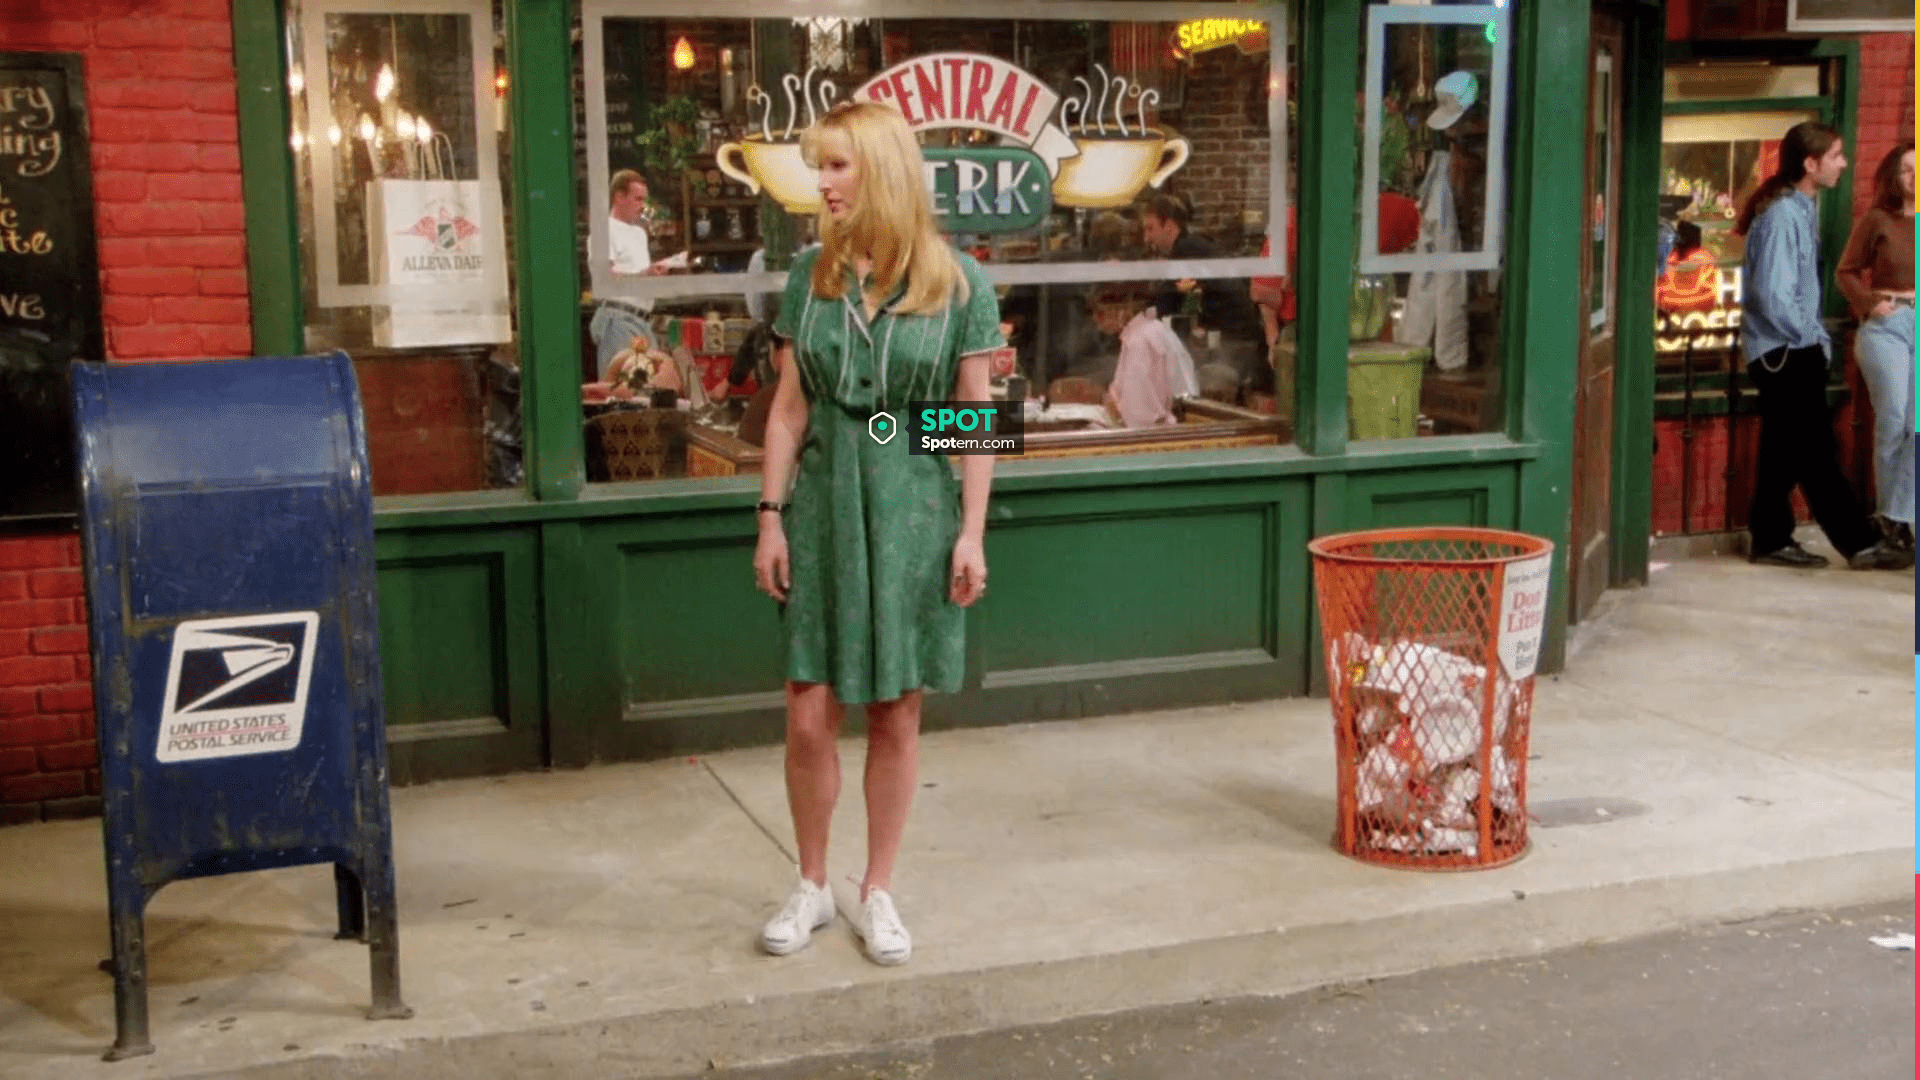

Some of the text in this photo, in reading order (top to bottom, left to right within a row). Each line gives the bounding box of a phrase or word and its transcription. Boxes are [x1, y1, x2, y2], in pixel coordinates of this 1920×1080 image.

[0, 86, 55, 129] ry
[923, 157, 1032, 215] ERK
[401, 254, 453, 271] ALLEVA
[168, 713, 287, 736] UNITED STATES
[167, 730, 291, 752] POSTAL SERVICE
